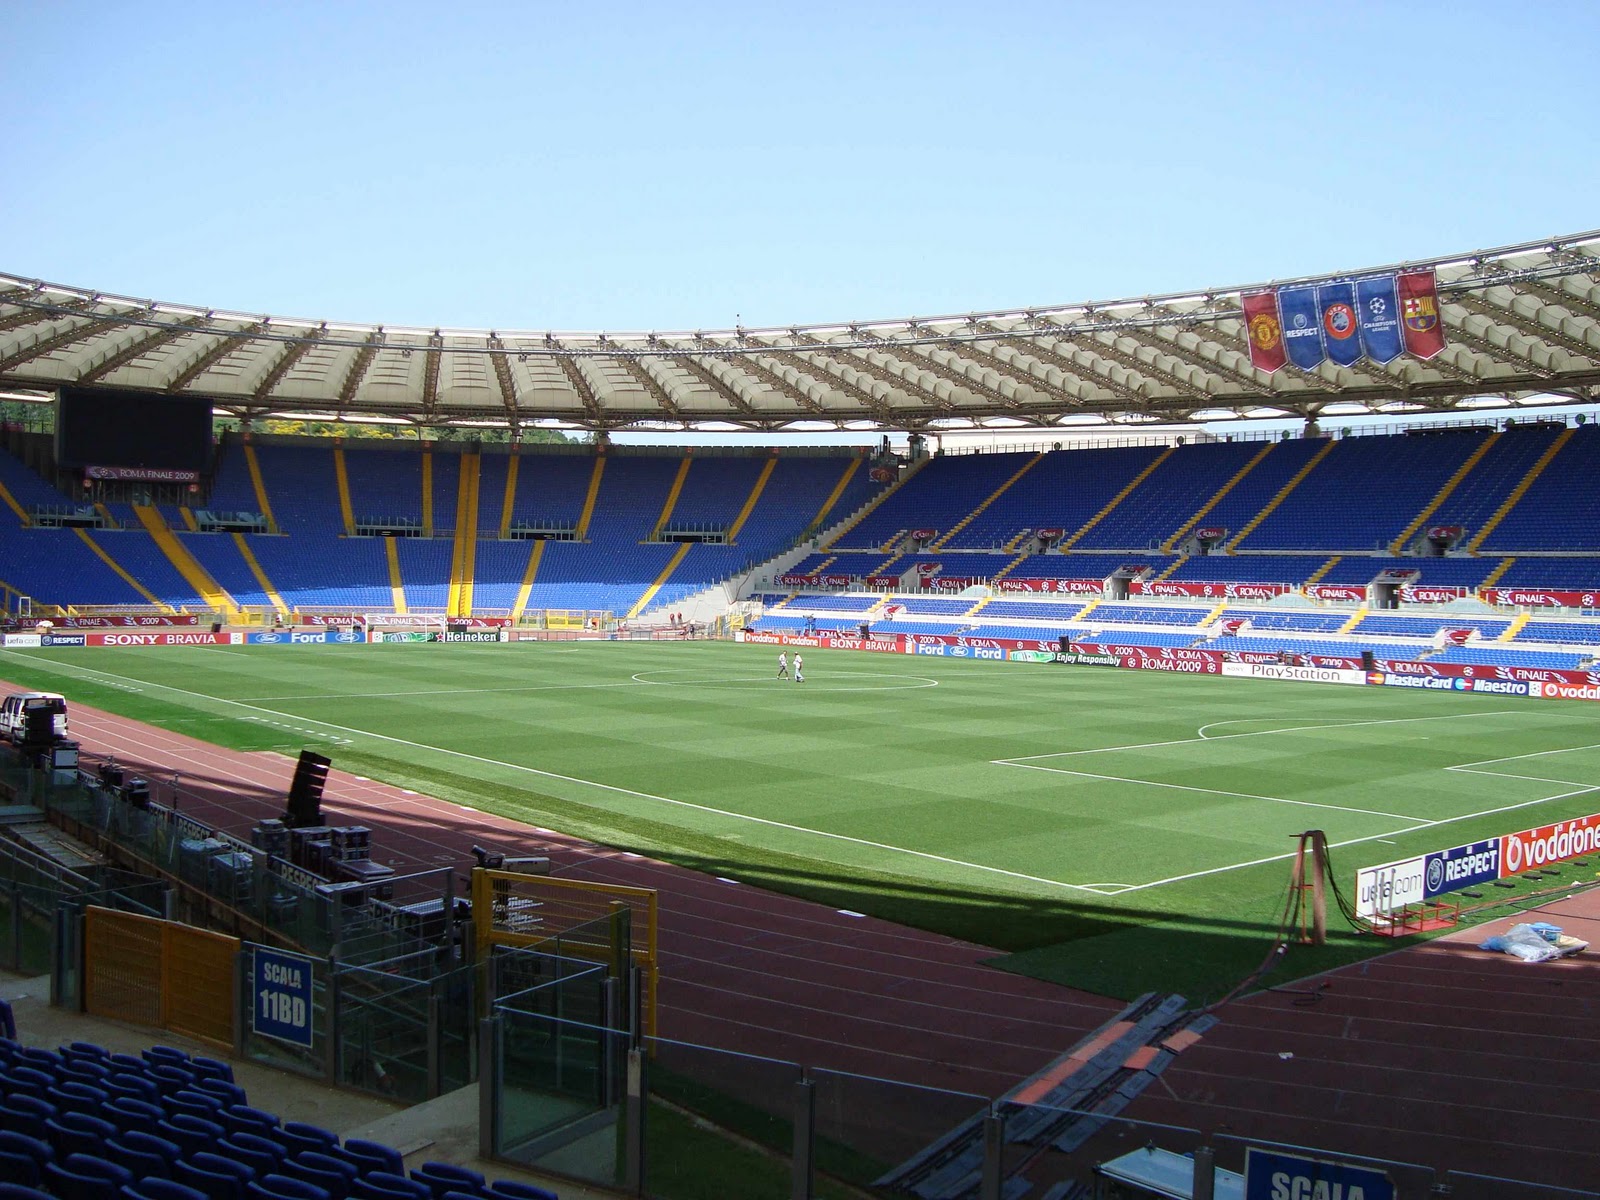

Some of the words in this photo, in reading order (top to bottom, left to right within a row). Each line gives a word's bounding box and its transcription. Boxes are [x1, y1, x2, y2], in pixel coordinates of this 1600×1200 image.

[1328, 306, 1347, 316] UEFA
[1286, 327, 1318, 338] RESPECT
[121, 469, 145, 478] ROMA
[148, 471, 172, 479] FINALE
[175, 472, 194, 480] 2009
[1070, 583, 1091, 591] ROMA
[1155, 585, 1177, 593] FINALE
[1240, 588, 1264, 596] ROMA
[1321, 589, 1347, 598] FINALE
[1515, 595, 1545, 603] FINALE
[104, 635, 159, 645] SONY
[167, 634, 216, 644] BRAVIA
[291, 633, 326, 643] Ford
[447, 632, 497, 641] Heineken
[750, 633, 779, 644] vodafone
[788, 635, 818, 646] vodafone
[830, 638, 862, 649] SONY
[865, 641, 896, 651] BRAVIA
[919, 643, 944, 655] Ford
[974, 647, 1002, 659] Ford
[920, 636, 935, 644] 2009
[970, 639, 990, 647] ROMA
[1052, 644, 1073, 652] FINE
[1115, 647, 1133, 655] 2009
[1178, 650, 1201, 659] ROMA
[1395, 662, 1424, 673] ROMA
[1516, 670, 1550, 680] FINALE
[1056, 652, 1076, 664] Enjoy
[1078, 654, 1121, 667] Responsibly
[1141, 658, 1174, 670] ROMA
[1176, 661, 1201, 672] 2009
[1252, 665, 1340, 680] PlayStation
[1385, 673, 1452, 689] MasterCard
[1474, 680, 1526, 694] Maestro
[1446, 850, 1498, 882] RESPECT
[264, 962, 302, 989] SCALA
[260, 989, 306, 1028] 11BD
